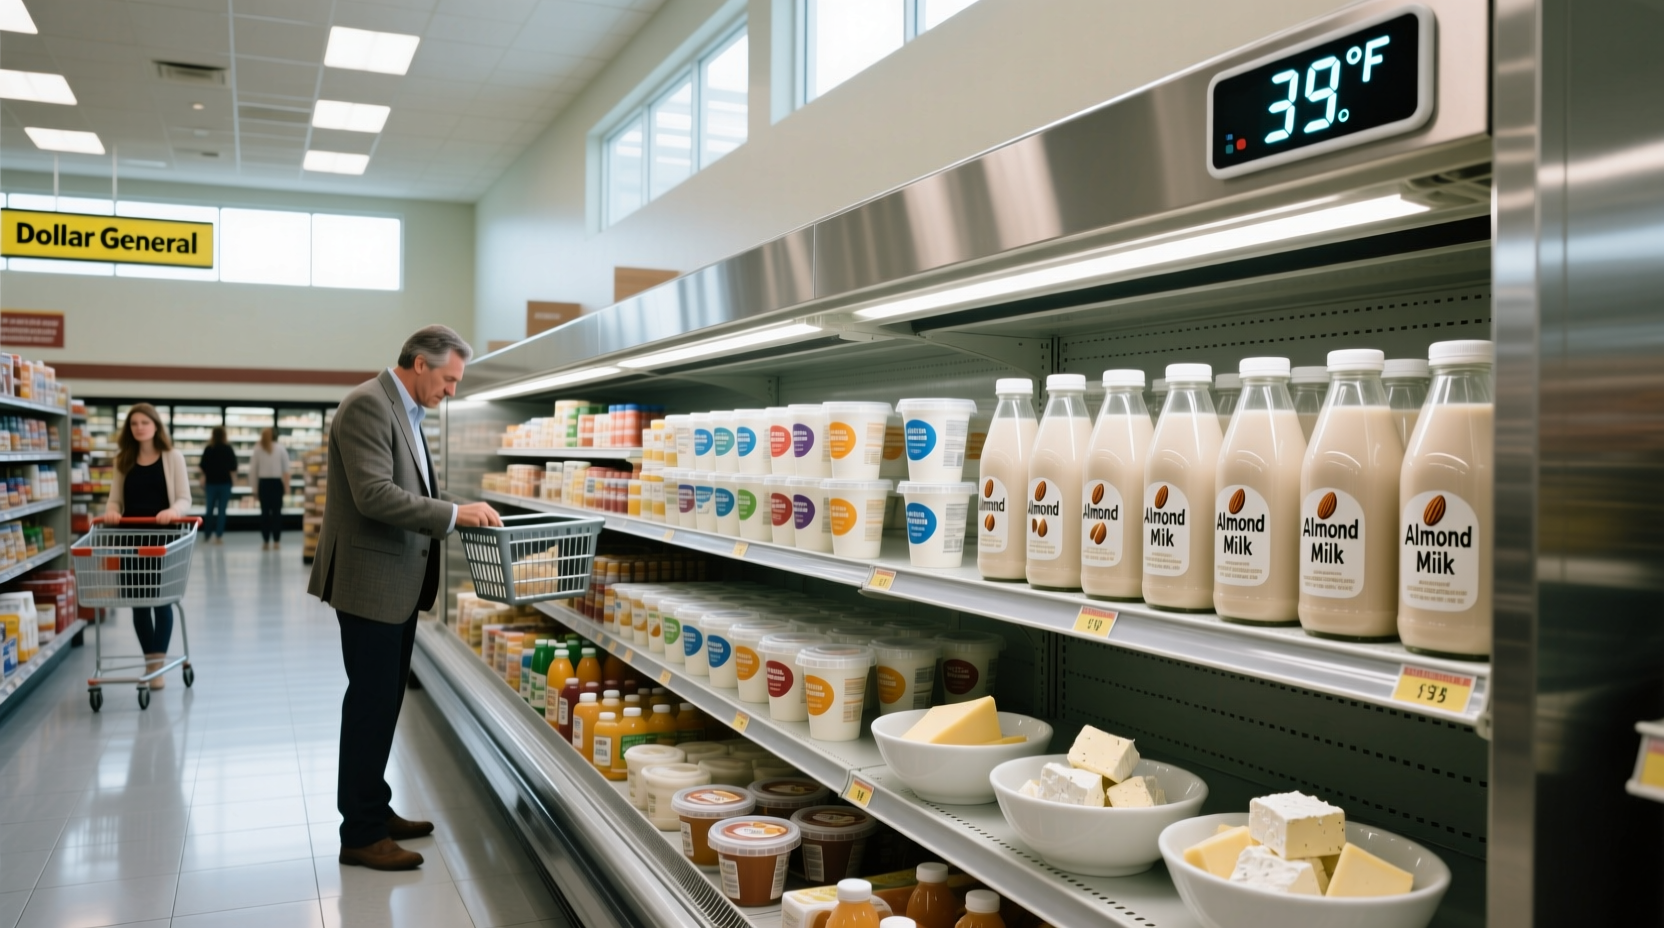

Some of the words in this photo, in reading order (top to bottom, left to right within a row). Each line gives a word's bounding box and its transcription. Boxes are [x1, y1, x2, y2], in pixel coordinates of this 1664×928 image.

[16, 221, 95, 248] Dollar
[100, 226, 197, 254] General
[1082, 502, 1119, 521] Almond
[1217, 511, 1265, 533] Almond
[1303, 517, 1359, 540] Almond
[1405, 523, 1473, 548] Almond
[1223, 535, 1253, 556] Milk
[1311, 542, 1344, 565] Milk
